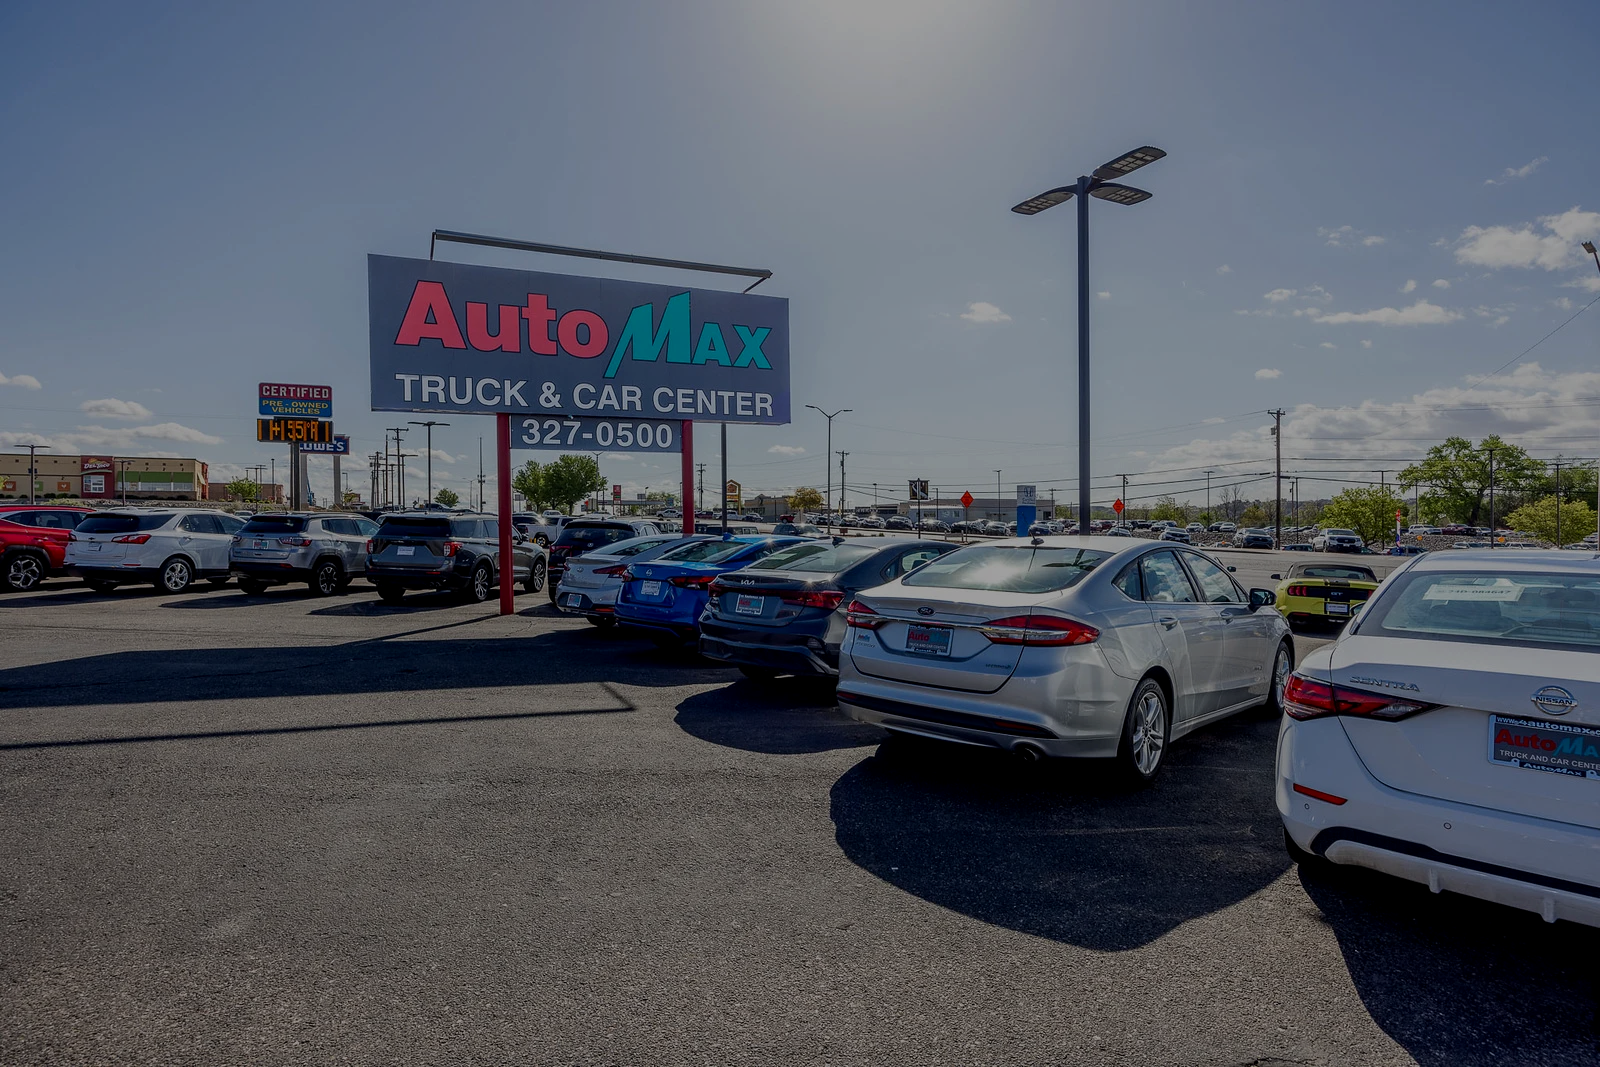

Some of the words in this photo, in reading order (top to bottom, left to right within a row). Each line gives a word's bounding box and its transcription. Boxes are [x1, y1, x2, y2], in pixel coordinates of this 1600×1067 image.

[262, 385, 329, 399] CERTIFIED
[394, 373, 529, 407] TRUCK
[538, 381, 562, 409] &
[572, 382, 643, 413] CAR
[652, 386, 774, 417] CENTER
[272, 407, 321, 415] VEHICLES
[521, 418, 673, 449] 327-0500
[1350, 676, 1420, 692] SENTRA
[1536, 696, 1573, 705] NISSAN
[1500, 749, 1528, 760] TRUCK
[1530, 754, 1549, 763] AND
[1551, 757, 1570, 766] CAR
